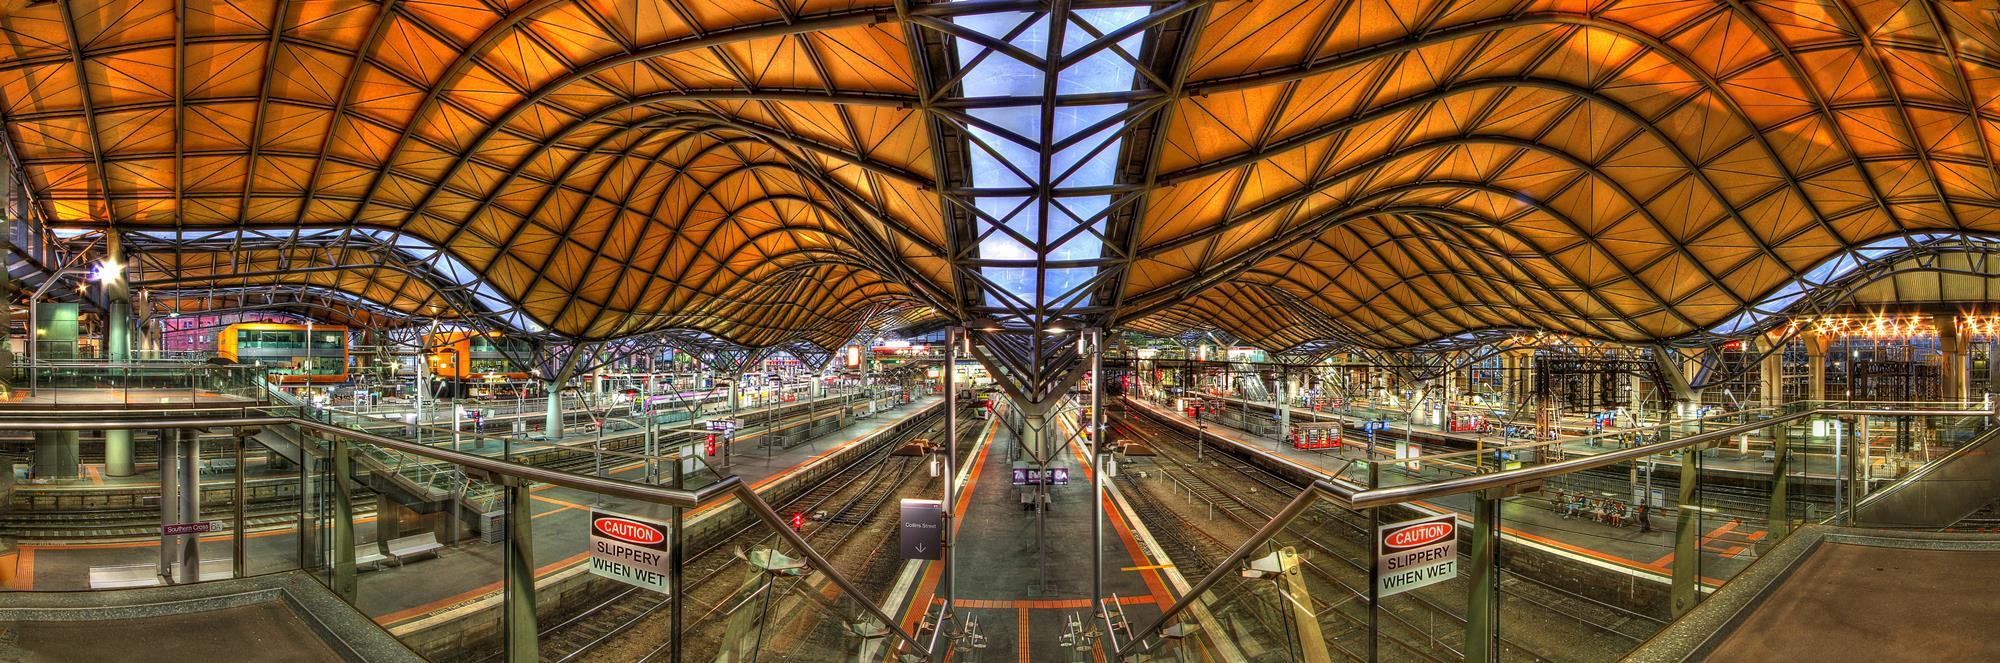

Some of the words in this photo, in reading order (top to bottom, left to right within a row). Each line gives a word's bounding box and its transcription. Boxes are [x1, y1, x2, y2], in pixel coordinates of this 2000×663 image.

[604, 520, 653, 542] CAUTION
[1396, 525, 1444, 545] CAUTION
[597, 541, 660, 567] SLIPPERY
[1388, 545, 1450, 570] SLIPPERY
[592, 557, 631, 578] WHEN
[635, 568, 666, 587] WET
[1383, 569, 1423, 590] WHEN
[1426, 561, 1454, 579] WET
